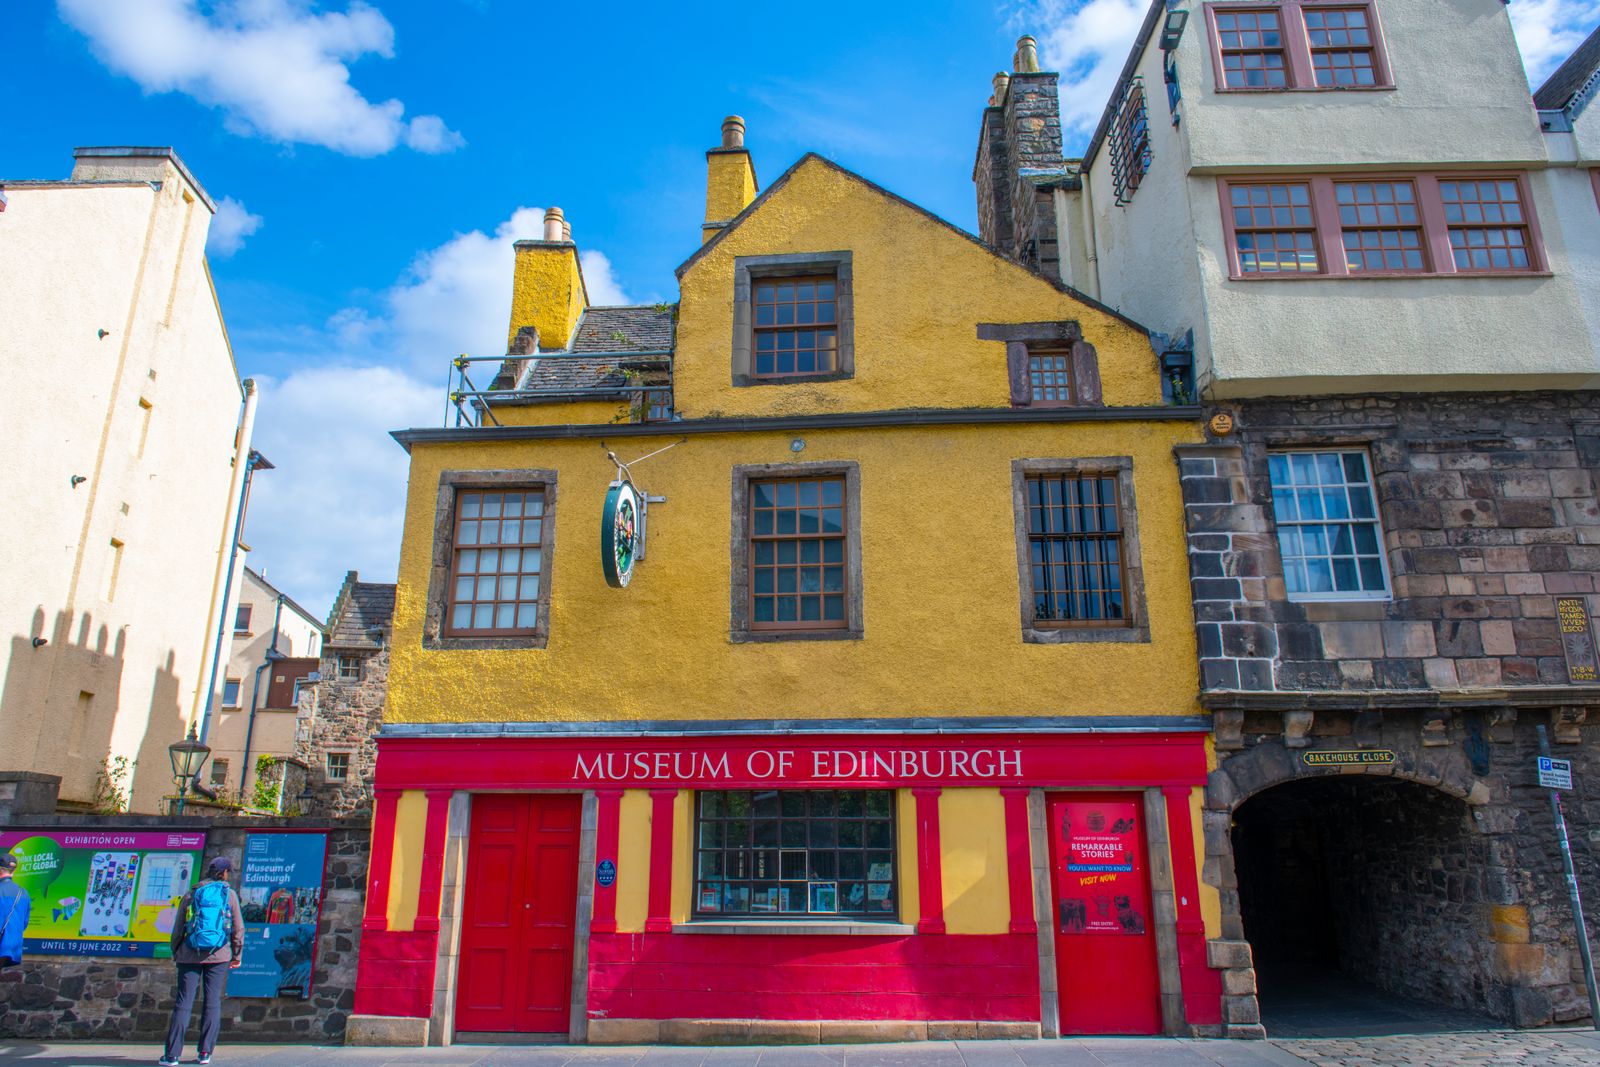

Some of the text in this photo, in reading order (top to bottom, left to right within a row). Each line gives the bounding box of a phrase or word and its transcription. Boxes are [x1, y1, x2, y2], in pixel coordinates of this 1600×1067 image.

[1309, 753, 1391, 762] BAKEHOUSE CLOSE
[571, 749, 1024, 780] MUSEUM OF EDINBURGH
[64, 836, 136, 845] EXHIBITION OPEN
[1071, 843, 1123, 851] REMARKABLE
[33, 852, 54, 862] LOCAL
[246, 863, 296, 873] Museum of
[245, 873, 291, 885] Edinburgh
[1080, 873, 1117, 887] VISIT NOW
[41, 941, 65, 950] UNTIL
[68, 942, 77, 950] 19
[78, 942, 99, 951] JUNE
[101, 943, 122, 951] 2022
